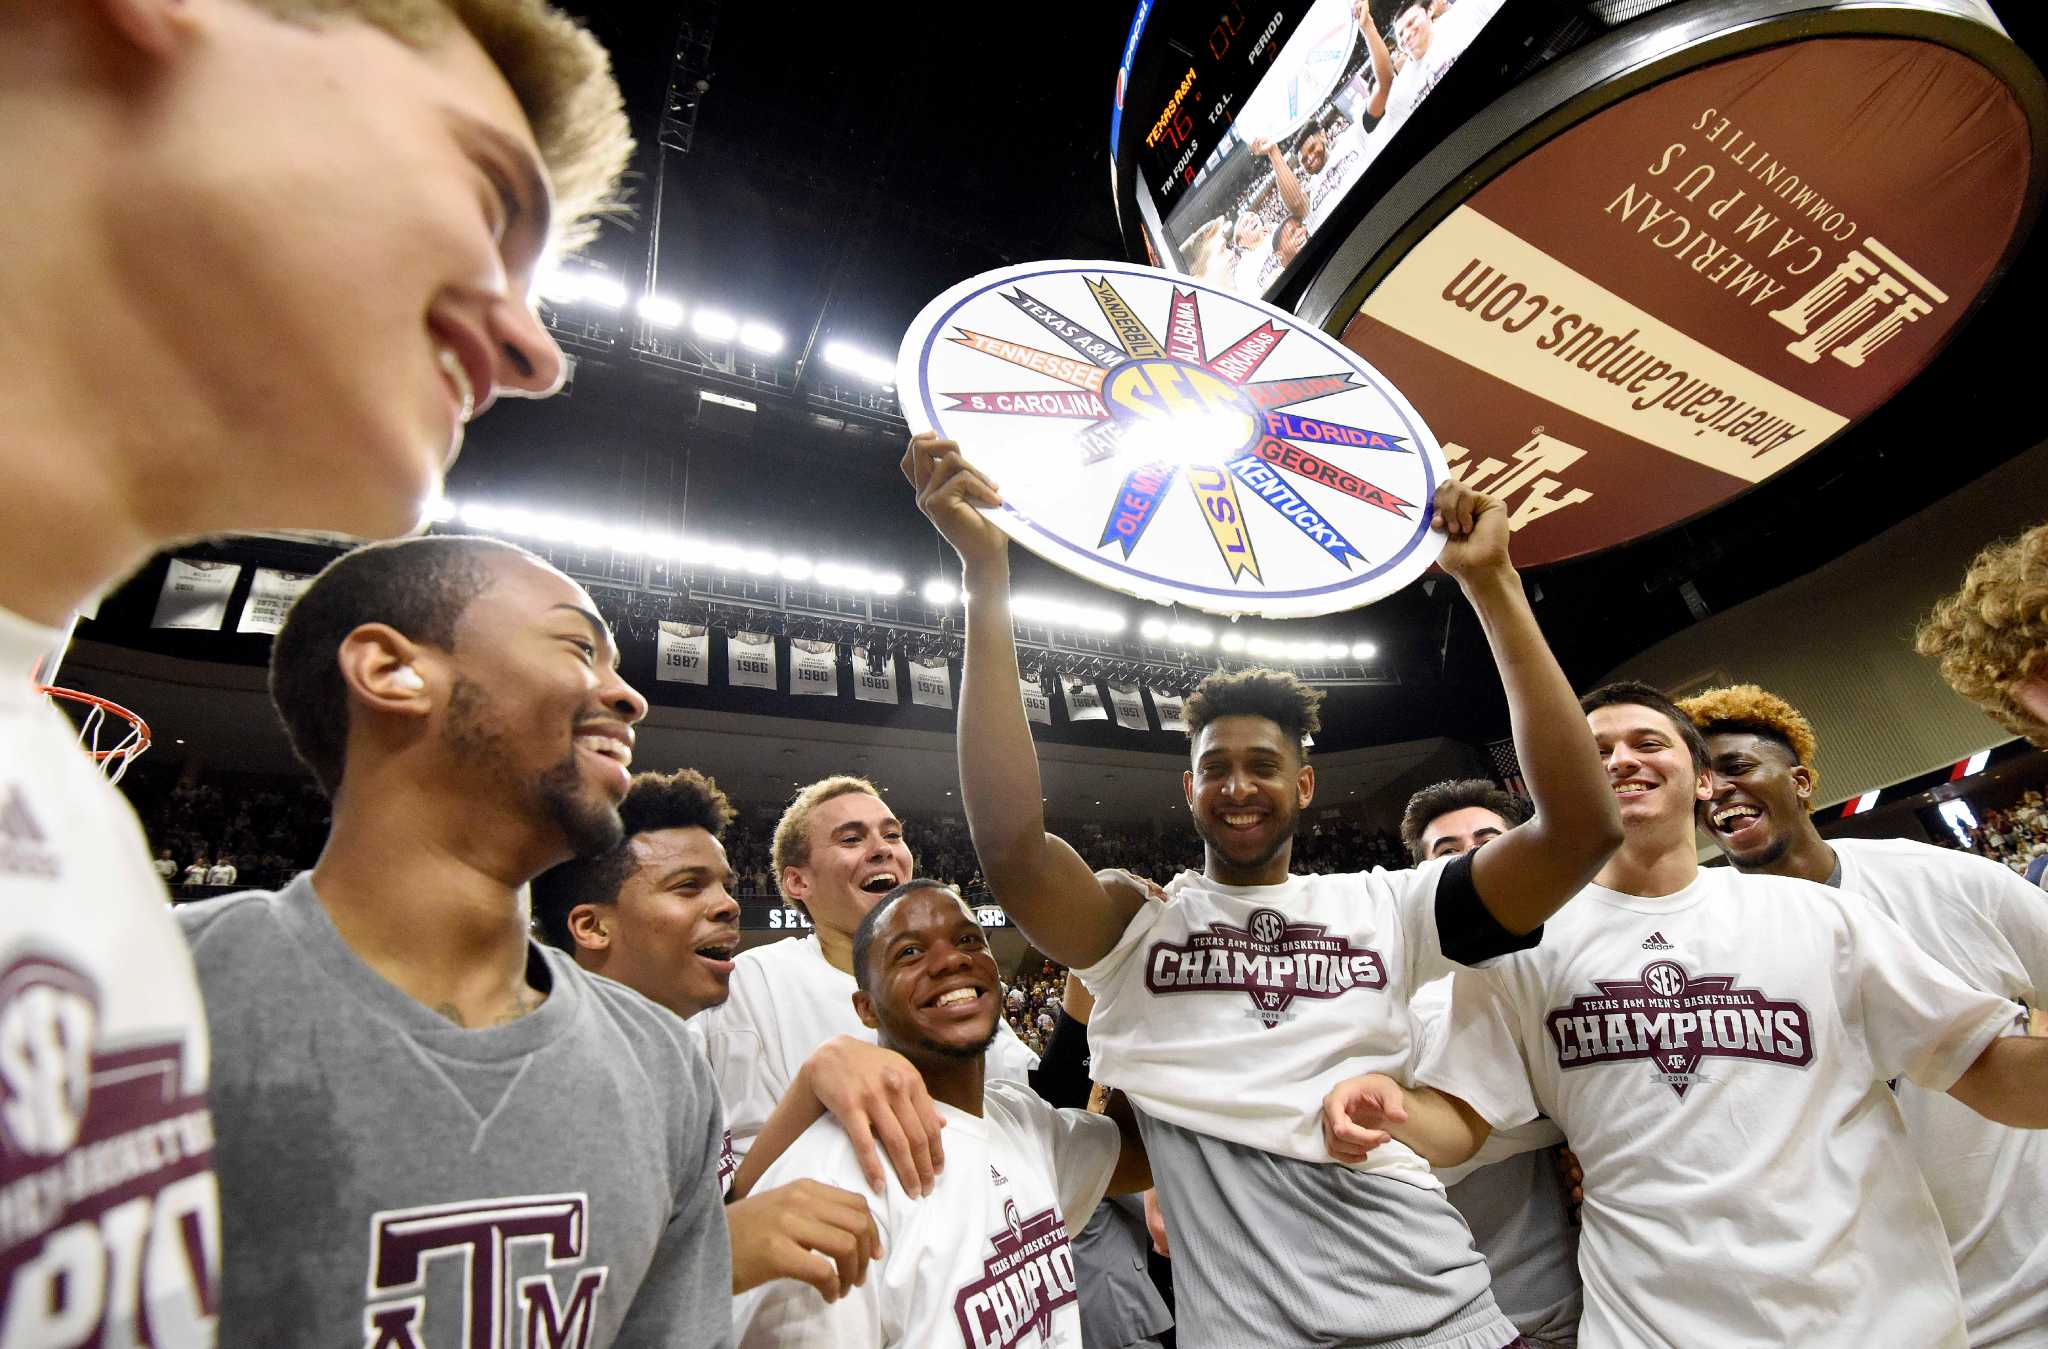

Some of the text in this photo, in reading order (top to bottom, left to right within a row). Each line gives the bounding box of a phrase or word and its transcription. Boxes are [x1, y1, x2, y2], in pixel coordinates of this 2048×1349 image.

[1248, 11, 1284, 65] PERIOD
[1160, 106, 1194, 149] 76
[1208, 92, 1233, 124] T.O.L.
[1161, 139, 1199, 196] TM FOULS
[1693, 108, 1857, 241] COMMUNITIES
[1648, 142, 1822, 275] CAMPUS
[1603, 183, 1787, 306] AMERICAN
[1022, 298, 1127, 369] TEXAS A&M
[1098, 288, 1162, 359] VANDERBILT
[1170, 302, 1199, 366] ALABAMA
[974, 334, 1104, 392] TENNESSEE
[1212, 330, 1276, 382] ARKANSAS
[1441, 257, 1808, 460] AmericanCampus.com
[971, 394, 1109, 417] S. CAROLINA
[1266, 414, 1390, 449] FLORIDA
[1262, 439, 1386, 505] GEORGIA
[1116, 494, 1150, 536] OLE
[1190, 464, 1246, 553] LSU
[1232, 456, 1347, 549] KENTUCKY
[666, 653, 699, 669] 1987
[736, 659, 769, 674] 1986
[798, 669, 828, 682] 1980
[861, 677, 890, 690] 1980
[918, 681, 945, 696] 1976
[1025, 697, 1047, 710] 969
[1193, 937, 1342, 953] TEXAS A&M MEN'S BASKETBALL
[1253, 915, 1284, 943] SEC
[1642, 942, 1675, 951] adidas
[1152, 948, 1381, 994] CHAMPIONS
[1647, 965, 1684, 997] SEC
[1582, 993, 1755, 1012] TEXAS A&M MEN'S BASKETBALL
[1554, 1008, 1803, 1061] CHAMPIONS
